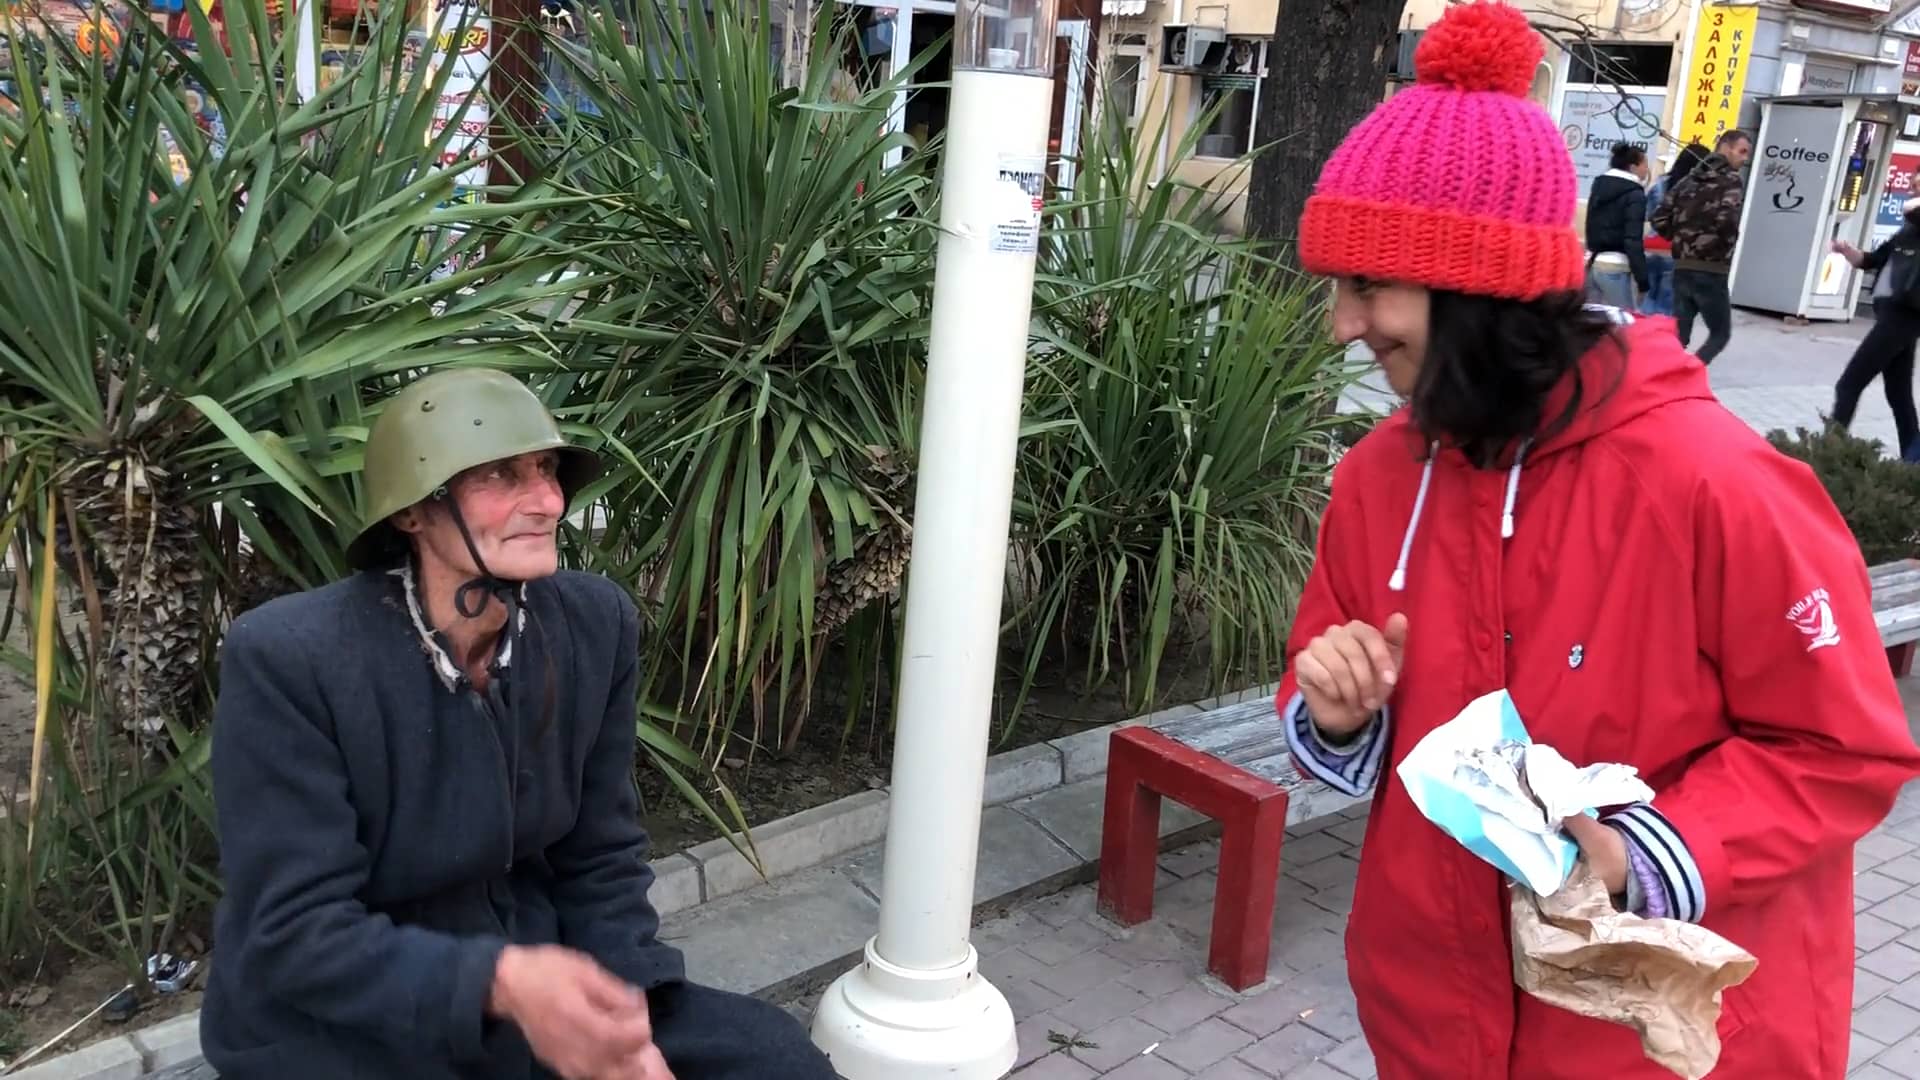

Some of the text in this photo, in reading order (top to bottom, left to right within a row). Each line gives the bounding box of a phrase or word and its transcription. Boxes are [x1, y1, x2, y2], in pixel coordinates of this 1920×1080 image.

[434, 28, 488, 52] NRF
[1694, 12, 1724, 125] ЗАЛОЖНА
[1720, 29, 1743, 109] КУПУВА
[1766, 145, 1830, 163] Coffee
